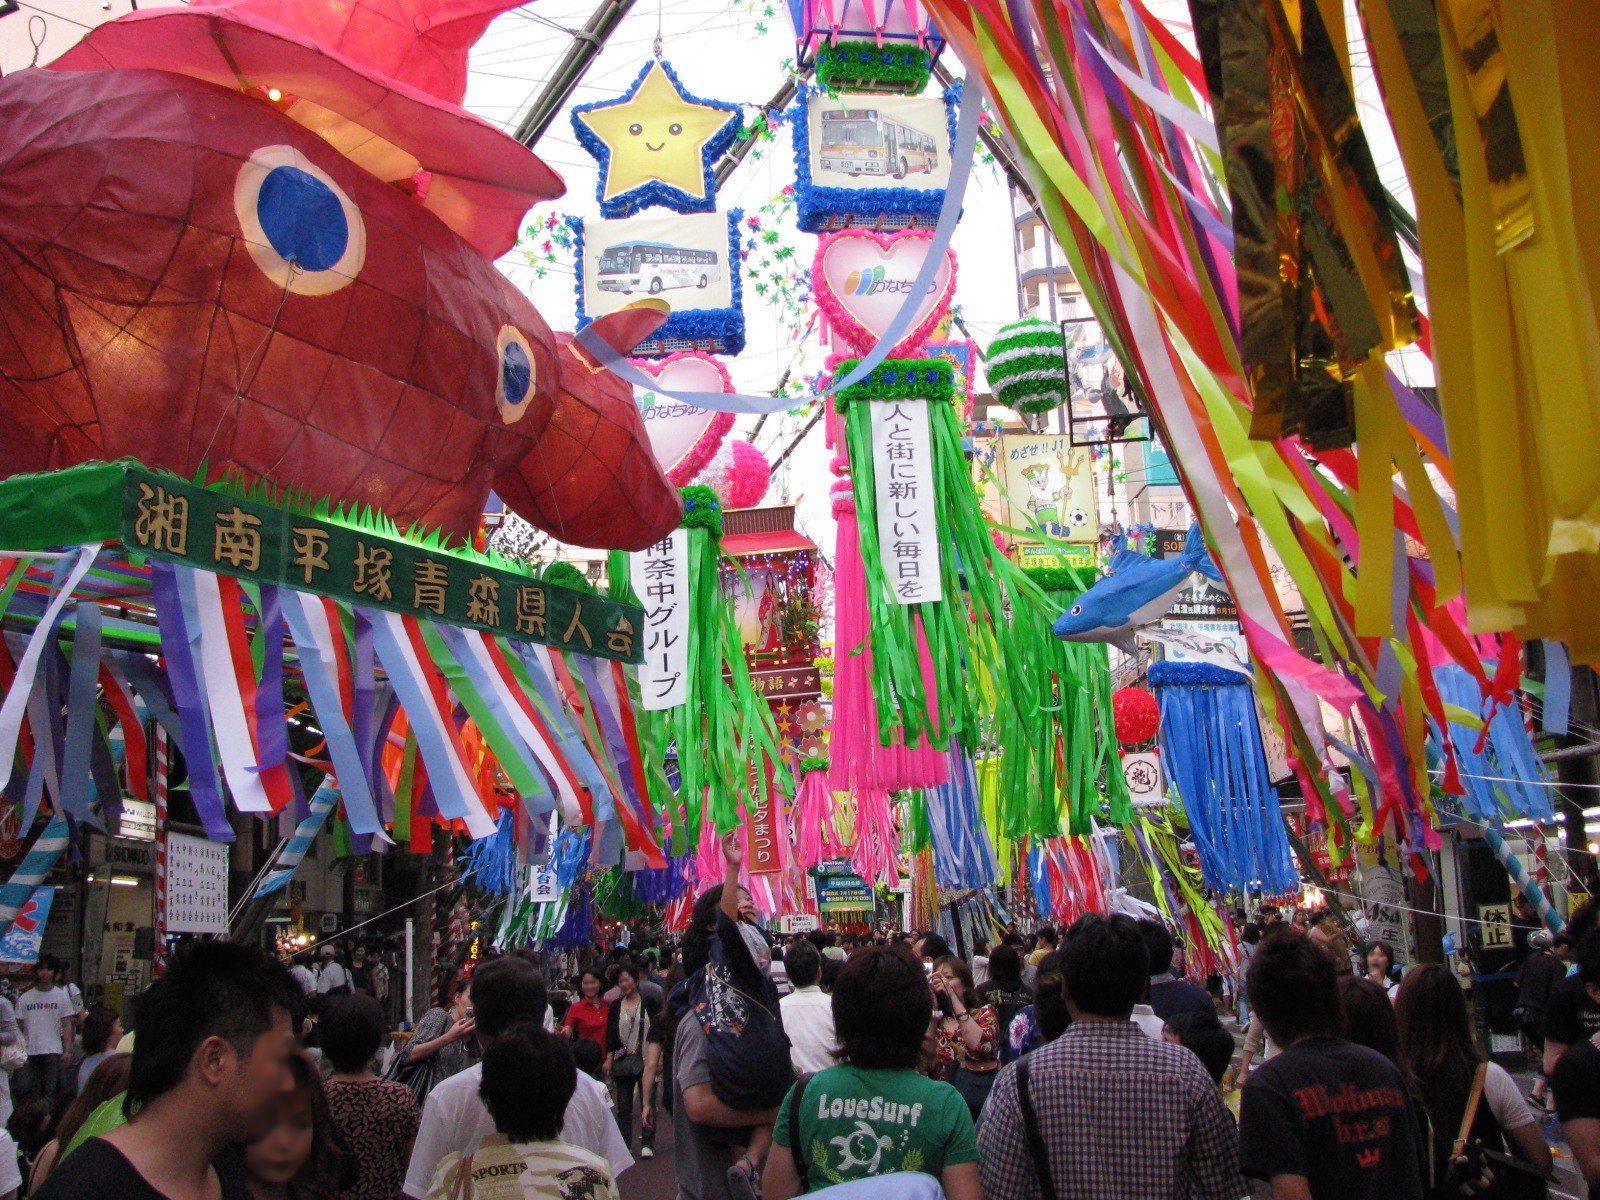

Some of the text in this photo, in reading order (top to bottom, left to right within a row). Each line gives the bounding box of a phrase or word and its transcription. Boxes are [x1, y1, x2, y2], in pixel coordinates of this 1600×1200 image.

[136, 481, 634, 657] 湘南平塚青森県人会
[884, 403, 924, 598] 人と街に新しい毎日を
[643, 537, 681, 698] 神奈中グループ
[472, 1162, 528, 1181] SPORTS
[818, 1093, 923, 1127] LoveSurf
